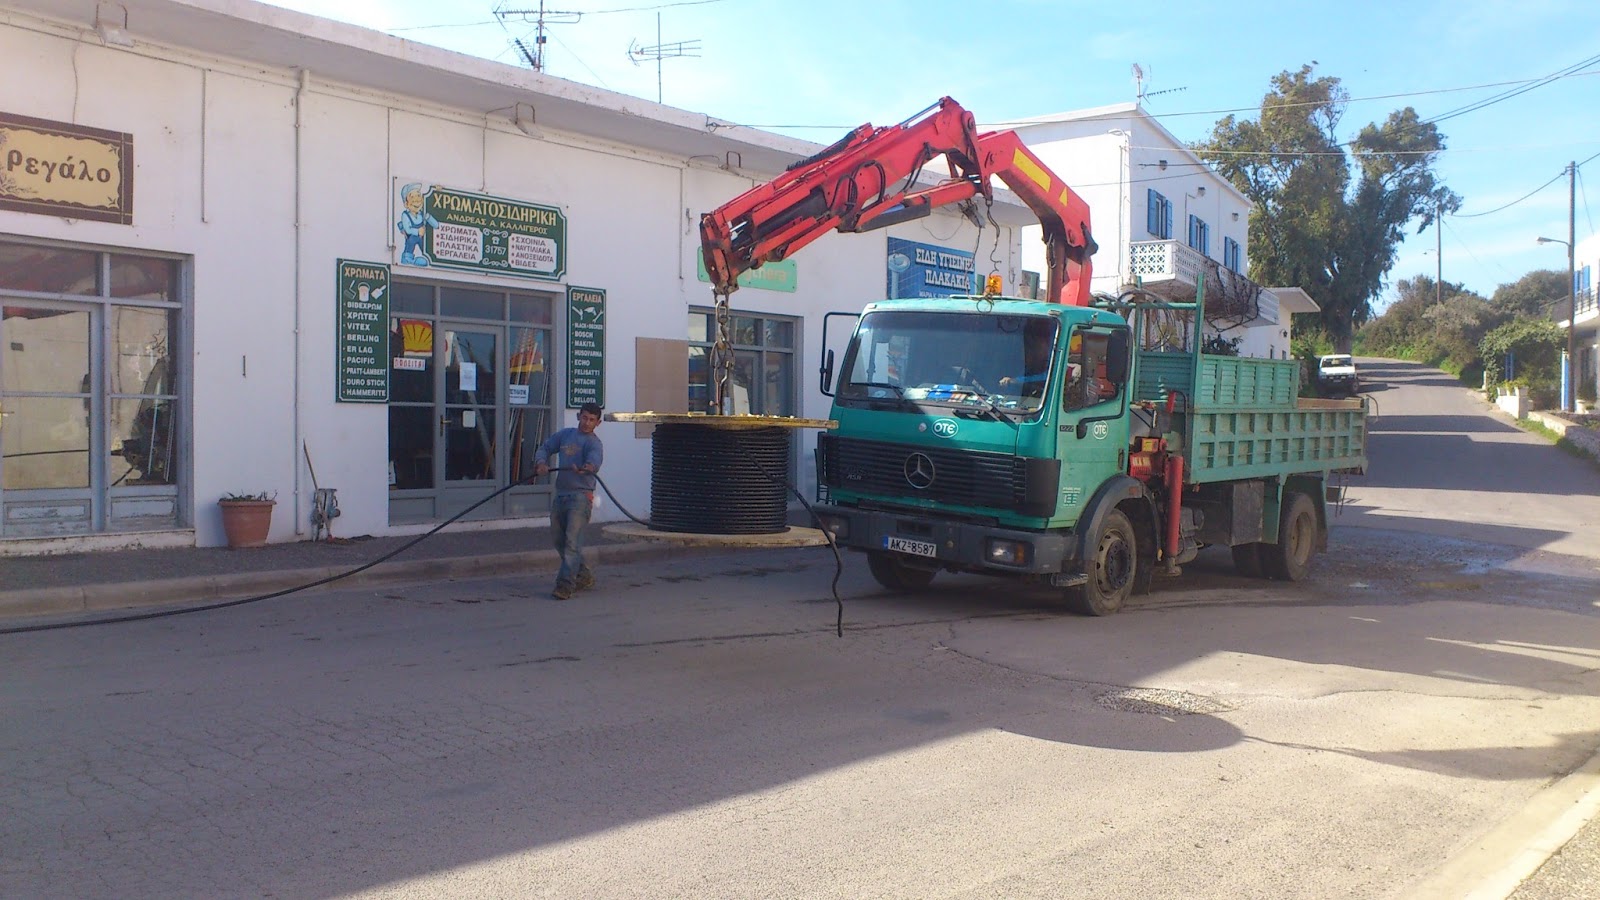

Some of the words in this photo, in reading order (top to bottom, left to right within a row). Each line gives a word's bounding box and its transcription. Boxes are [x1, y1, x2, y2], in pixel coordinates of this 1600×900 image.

[6, 149, 111, 183] ρεγάλο
[432, 192, 557, 226] ΧΡΩΜΑΤΟΣΙΔΗΡΙΚΗ
[446, 213, 486, 226] ΑΝΔΡΕΑΣ
[500, 221, 548, 235] ΚΑΛΛΙΓΕΡΟΣ
[440, 225, 477, 236] ΧΡΩΜΑΤΑ
[440, 233, 478, 245] ΣΙΔΗΡΙΚΑ
[515, 236, 546, 246] ΣΧΟΙΝΙΑ
[440, 241, 479, 252] ΠΛΑΣΤΙΚΑ
[485, 244, 506, 255] 31757
[515, 244, 551, 255] ΝΑΥΤΙΛΙΑΚΑ
[440, 249, 476, 260] ΕΡΓΑΛΕΙΑ
[515, 252, 554, 263] ΑΝΟΞΕΙΔΟΤΑ
[915, 248, 937, 266] ΕΙΔΗ
[515, 259, 537, 268] ΒΙΔΕΣ
[344, 266, 385, 281] ΧΡΩΜΑΤΑ
[925, 269, 971, 290] ΠΛΑΚΑΚΙΑ
[572, 291, 602, 304] ΕΡΓΑΛΕΙΑ
[346, 322, 370, 331] VITEX
[346, 334, 380, 343] BERLING
[574, 340, 595, 348] MAKITA
[346, 356, 375, 365] PACIFIC
[574, 359, 591, 367] ECHO
[346, 378, 365, 386] DURO
[366, 379, 386, 387] STICK
[574, 378, 596, 386] HITACHI
[346, 388, 386, 397] HAMMERITE
[574, 396, 597, 404] BELLOTA
[934, 422, 956, 434] ΟΤΕ
[1094, 424, 1107, 435] ΟΤΕ
